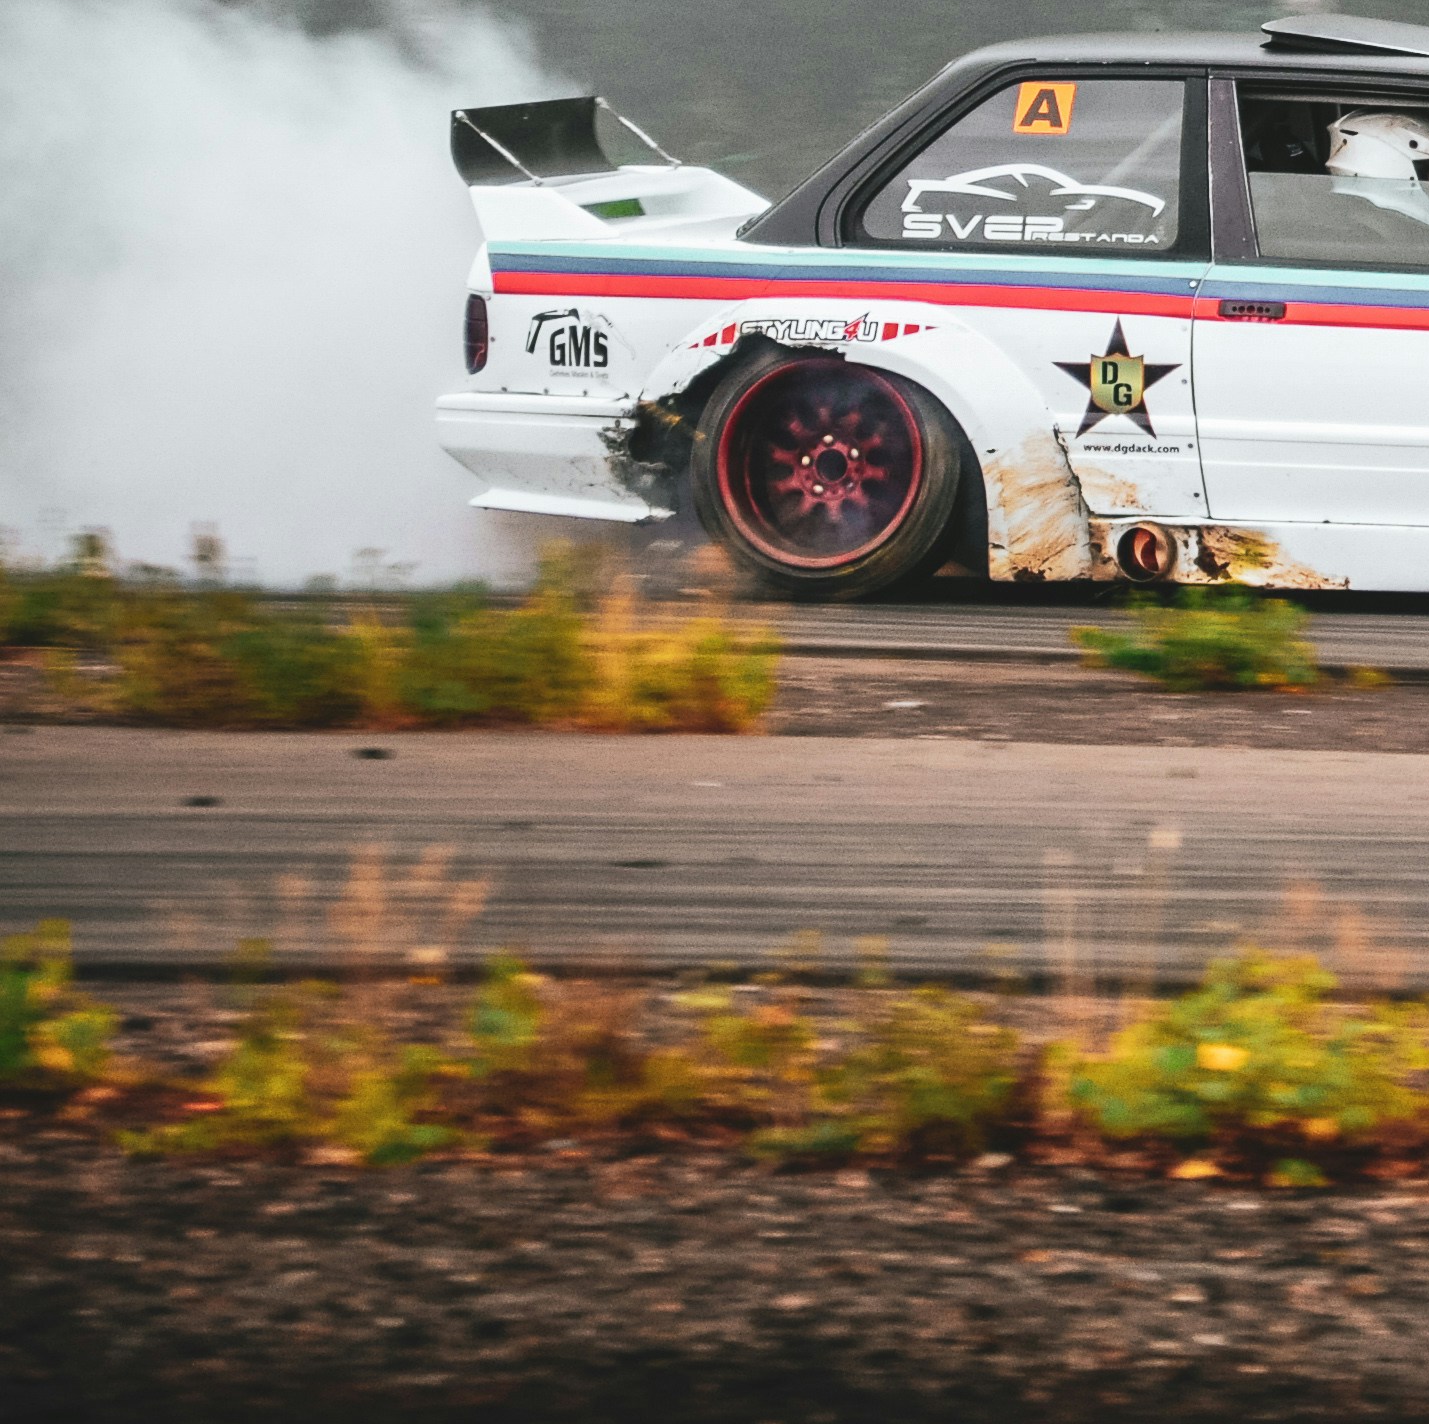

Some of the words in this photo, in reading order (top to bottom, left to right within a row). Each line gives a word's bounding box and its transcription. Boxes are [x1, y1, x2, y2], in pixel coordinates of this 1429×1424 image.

[1019, 89, 1063, 128] A
[549, 325, 608, 368] GMS
[1083, 444, 1180, 454] www.dgdack.com
